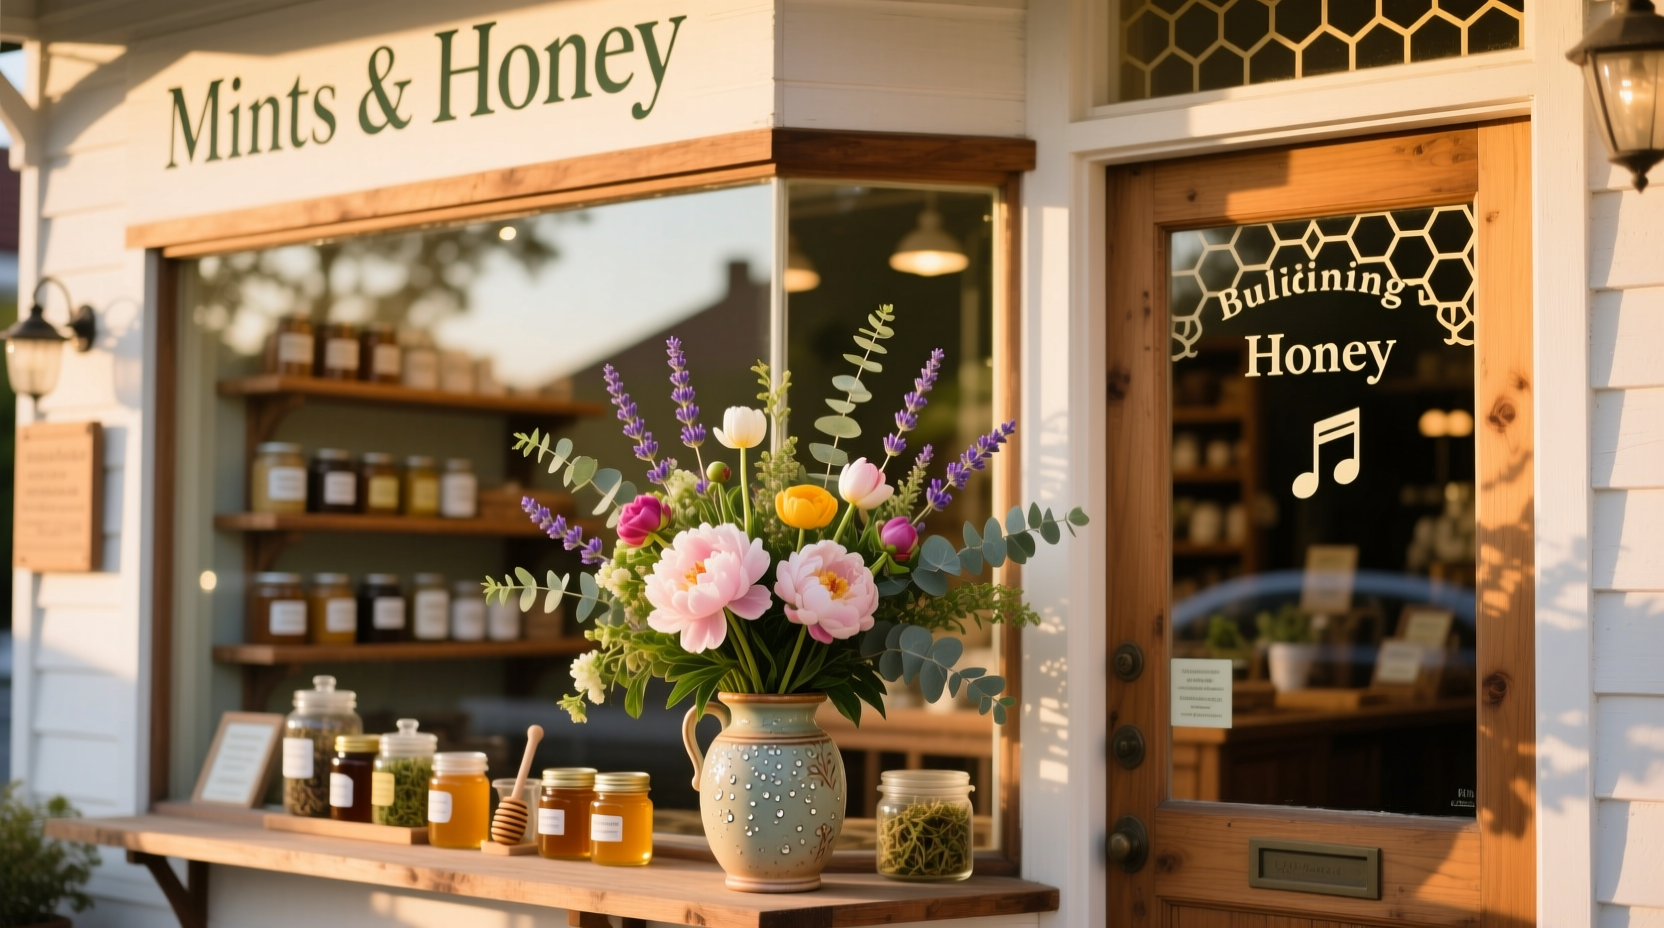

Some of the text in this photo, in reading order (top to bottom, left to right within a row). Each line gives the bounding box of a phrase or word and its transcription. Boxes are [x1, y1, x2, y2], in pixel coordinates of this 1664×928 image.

[165, 15, 688, 170] Mints & Honey
[1244, 333, 1397, 385] Honey
